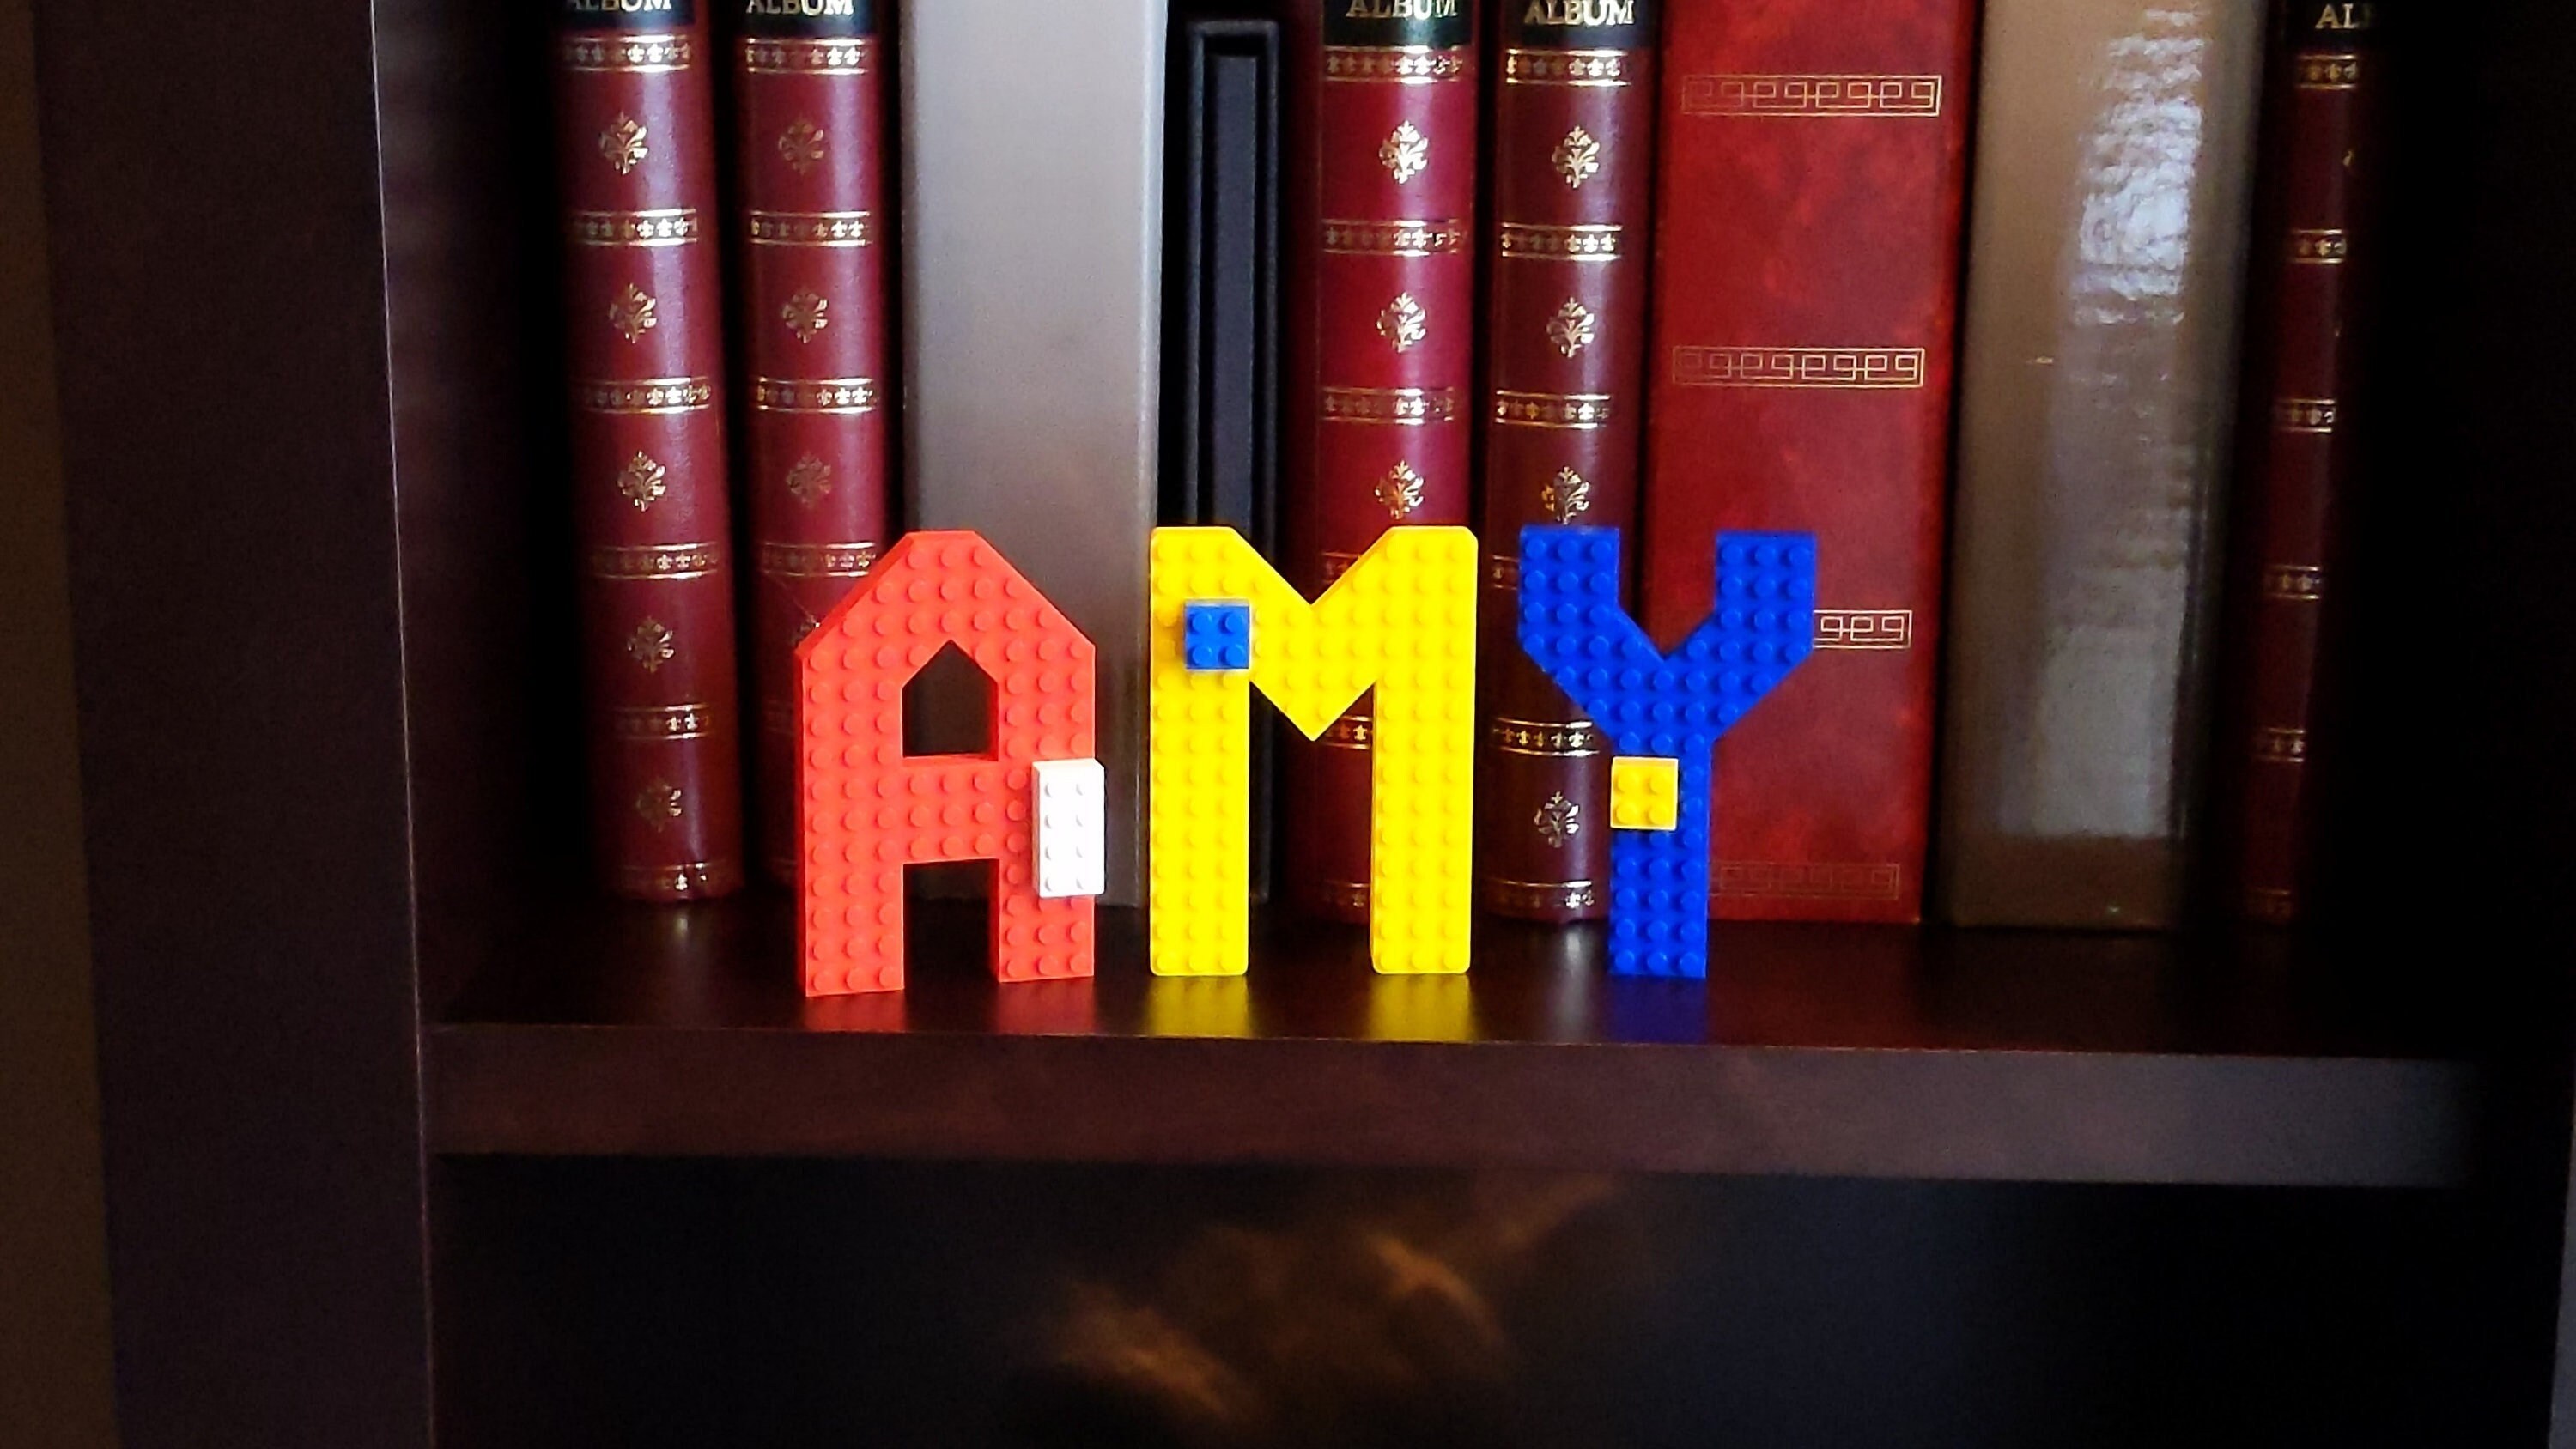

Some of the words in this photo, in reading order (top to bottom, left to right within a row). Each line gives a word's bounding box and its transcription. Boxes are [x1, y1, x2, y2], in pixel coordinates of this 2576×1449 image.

[1346, 0, 1458, 20] ALBUM
[1524, 0, 1634, 26] ALBUM
[796, 527, 1817, 996] AMY
